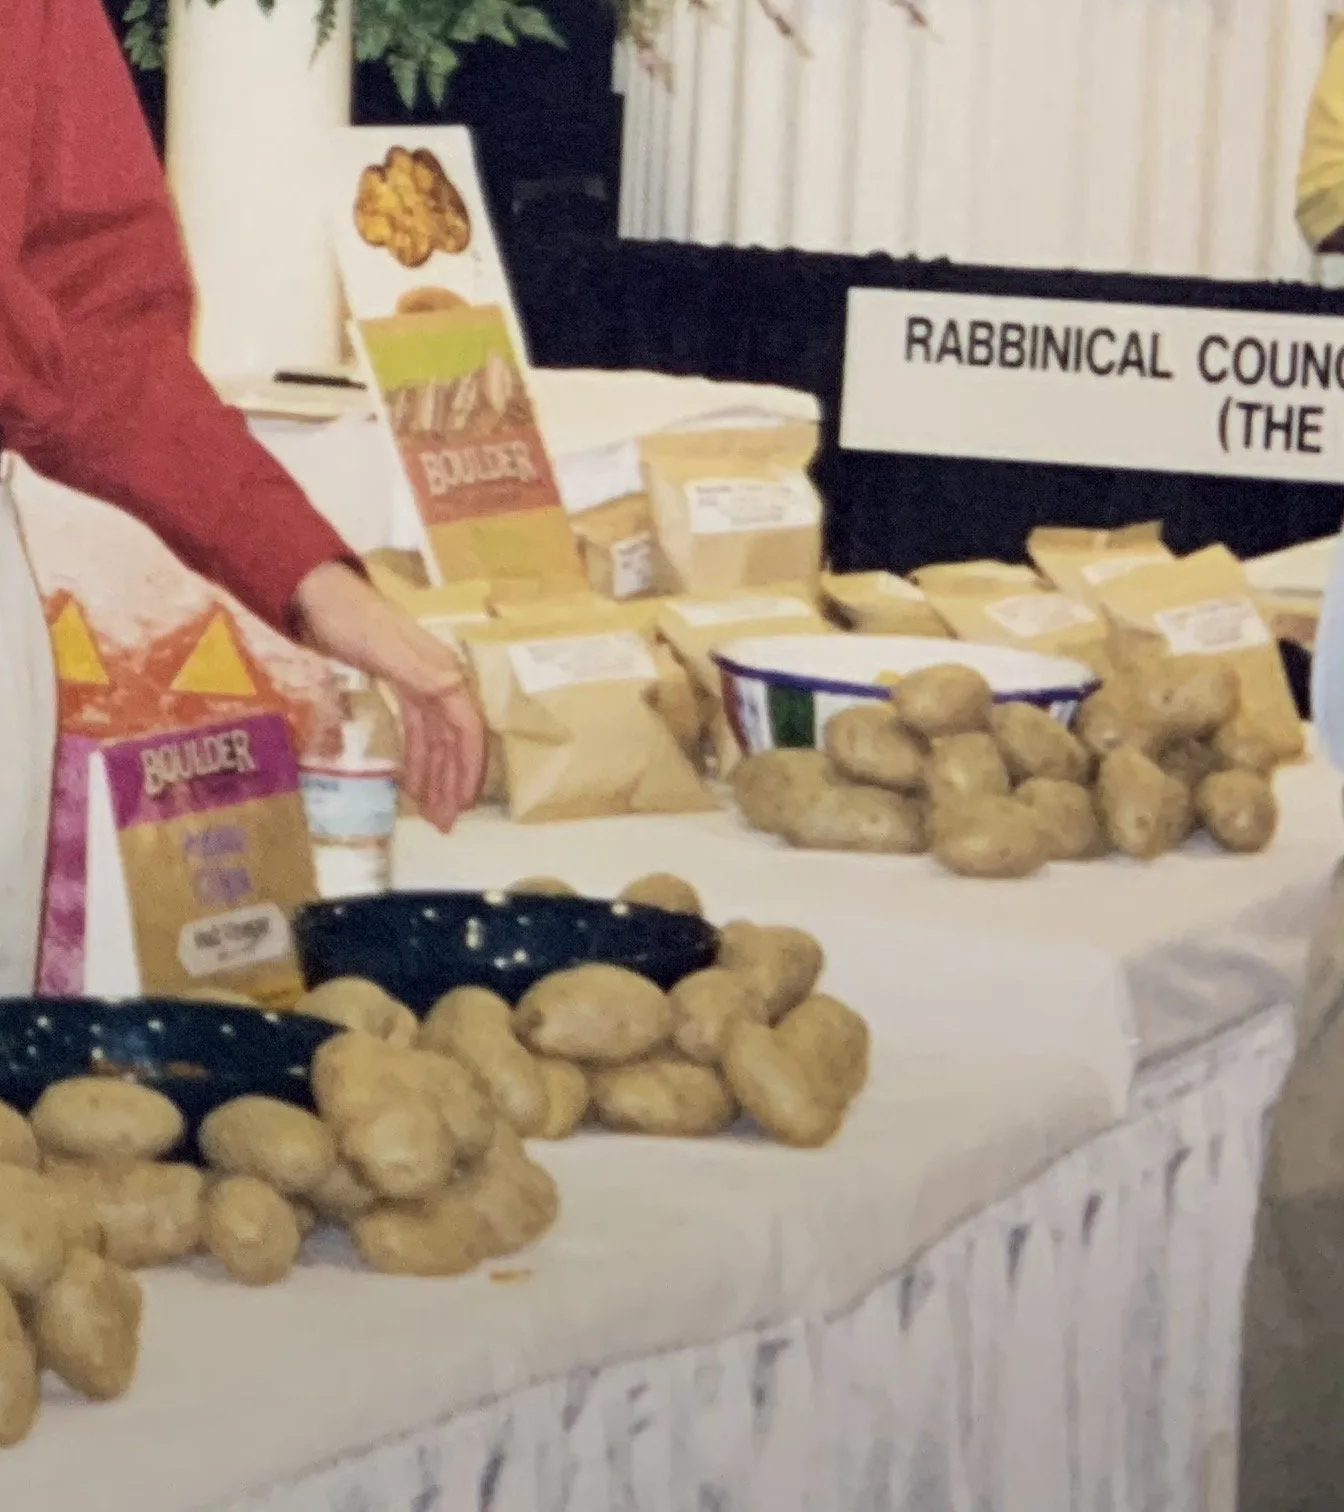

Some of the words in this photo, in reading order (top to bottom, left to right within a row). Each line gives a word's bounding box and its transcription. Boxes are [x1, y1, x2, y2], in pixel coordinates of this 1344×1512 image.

[905, 315, 1175, 380] RABBINICAL
[1217, 394, 1326, 455] (THE
[419, 439, 538, 497] BOULDER
[139, 728, 256, 795] BOULDER
